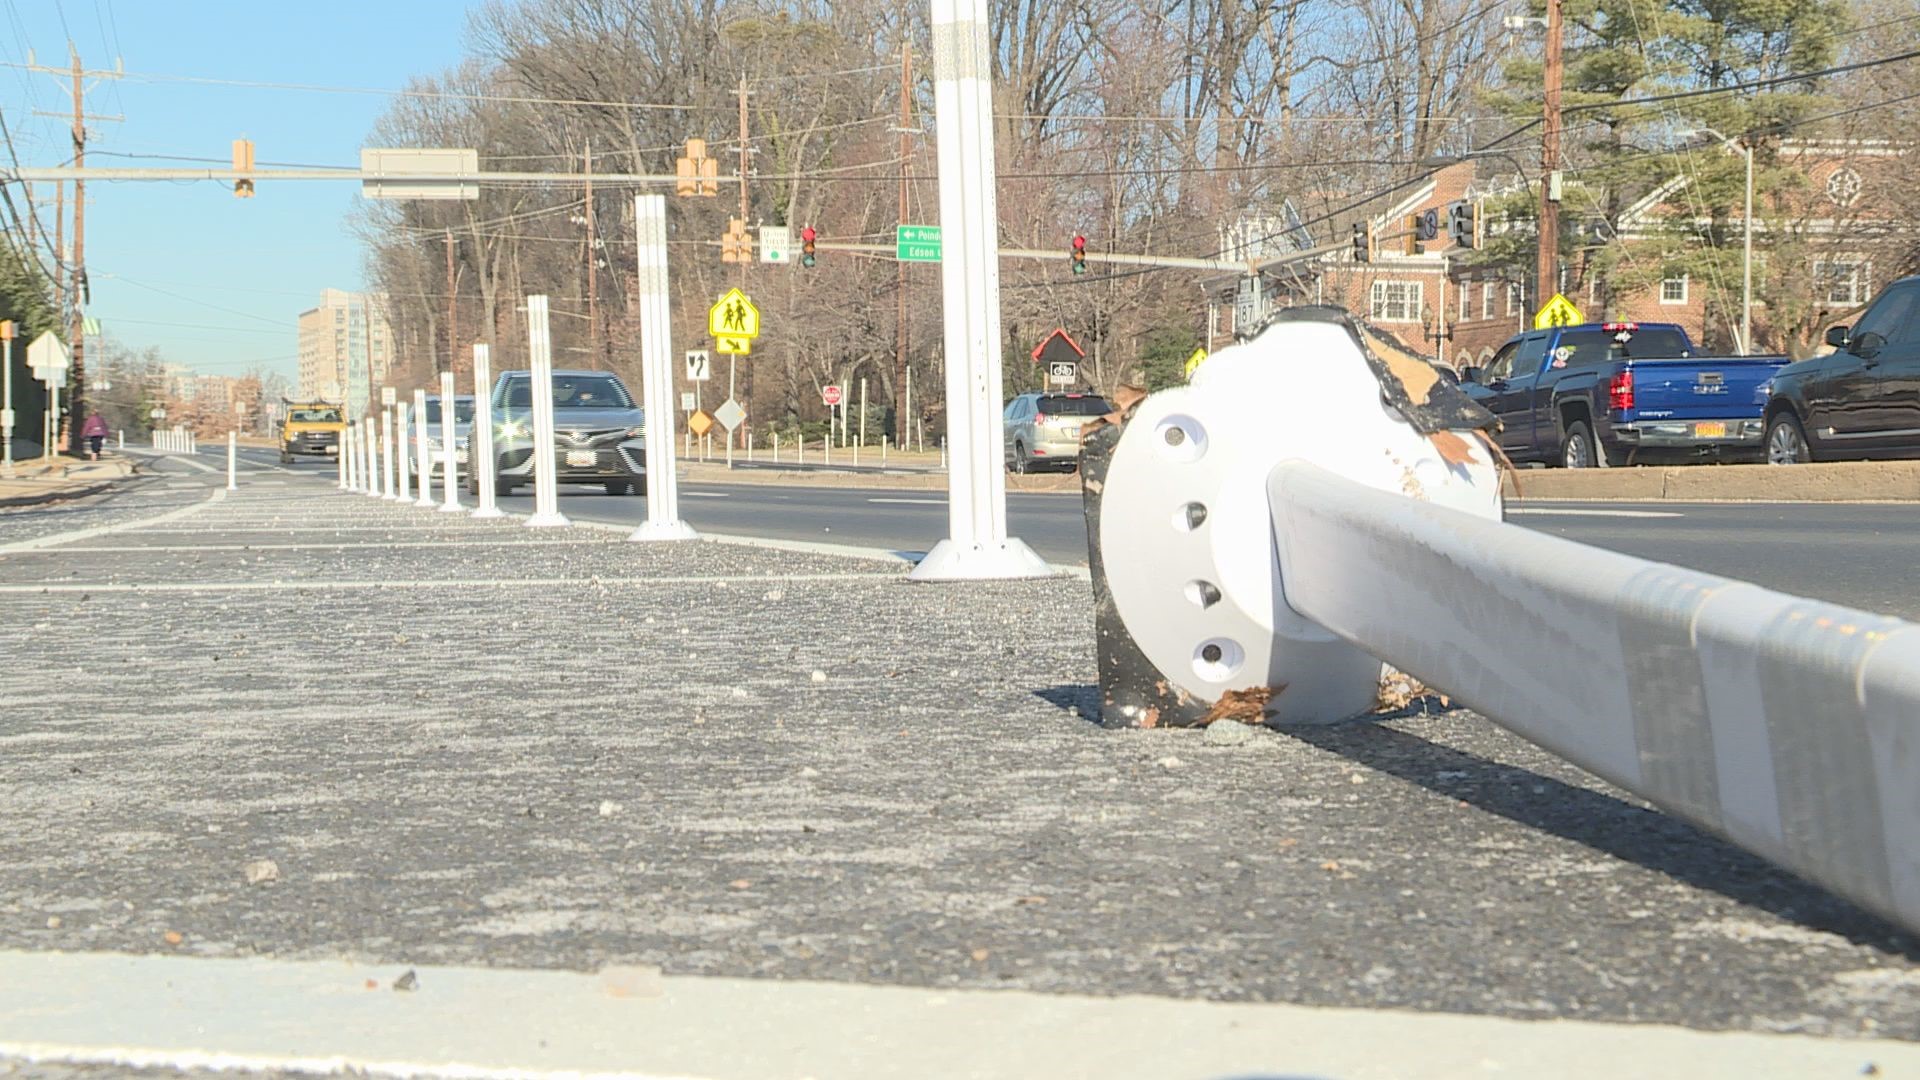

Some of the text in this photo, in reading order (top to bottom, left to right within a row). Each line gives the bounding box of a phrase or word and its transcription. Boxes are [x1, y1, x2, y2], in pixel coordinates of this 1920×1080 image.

[918, 230, 941, 241] Poind
[909, 247, 934, 257] Edson
[1238, 304, 1253, 322] 187
